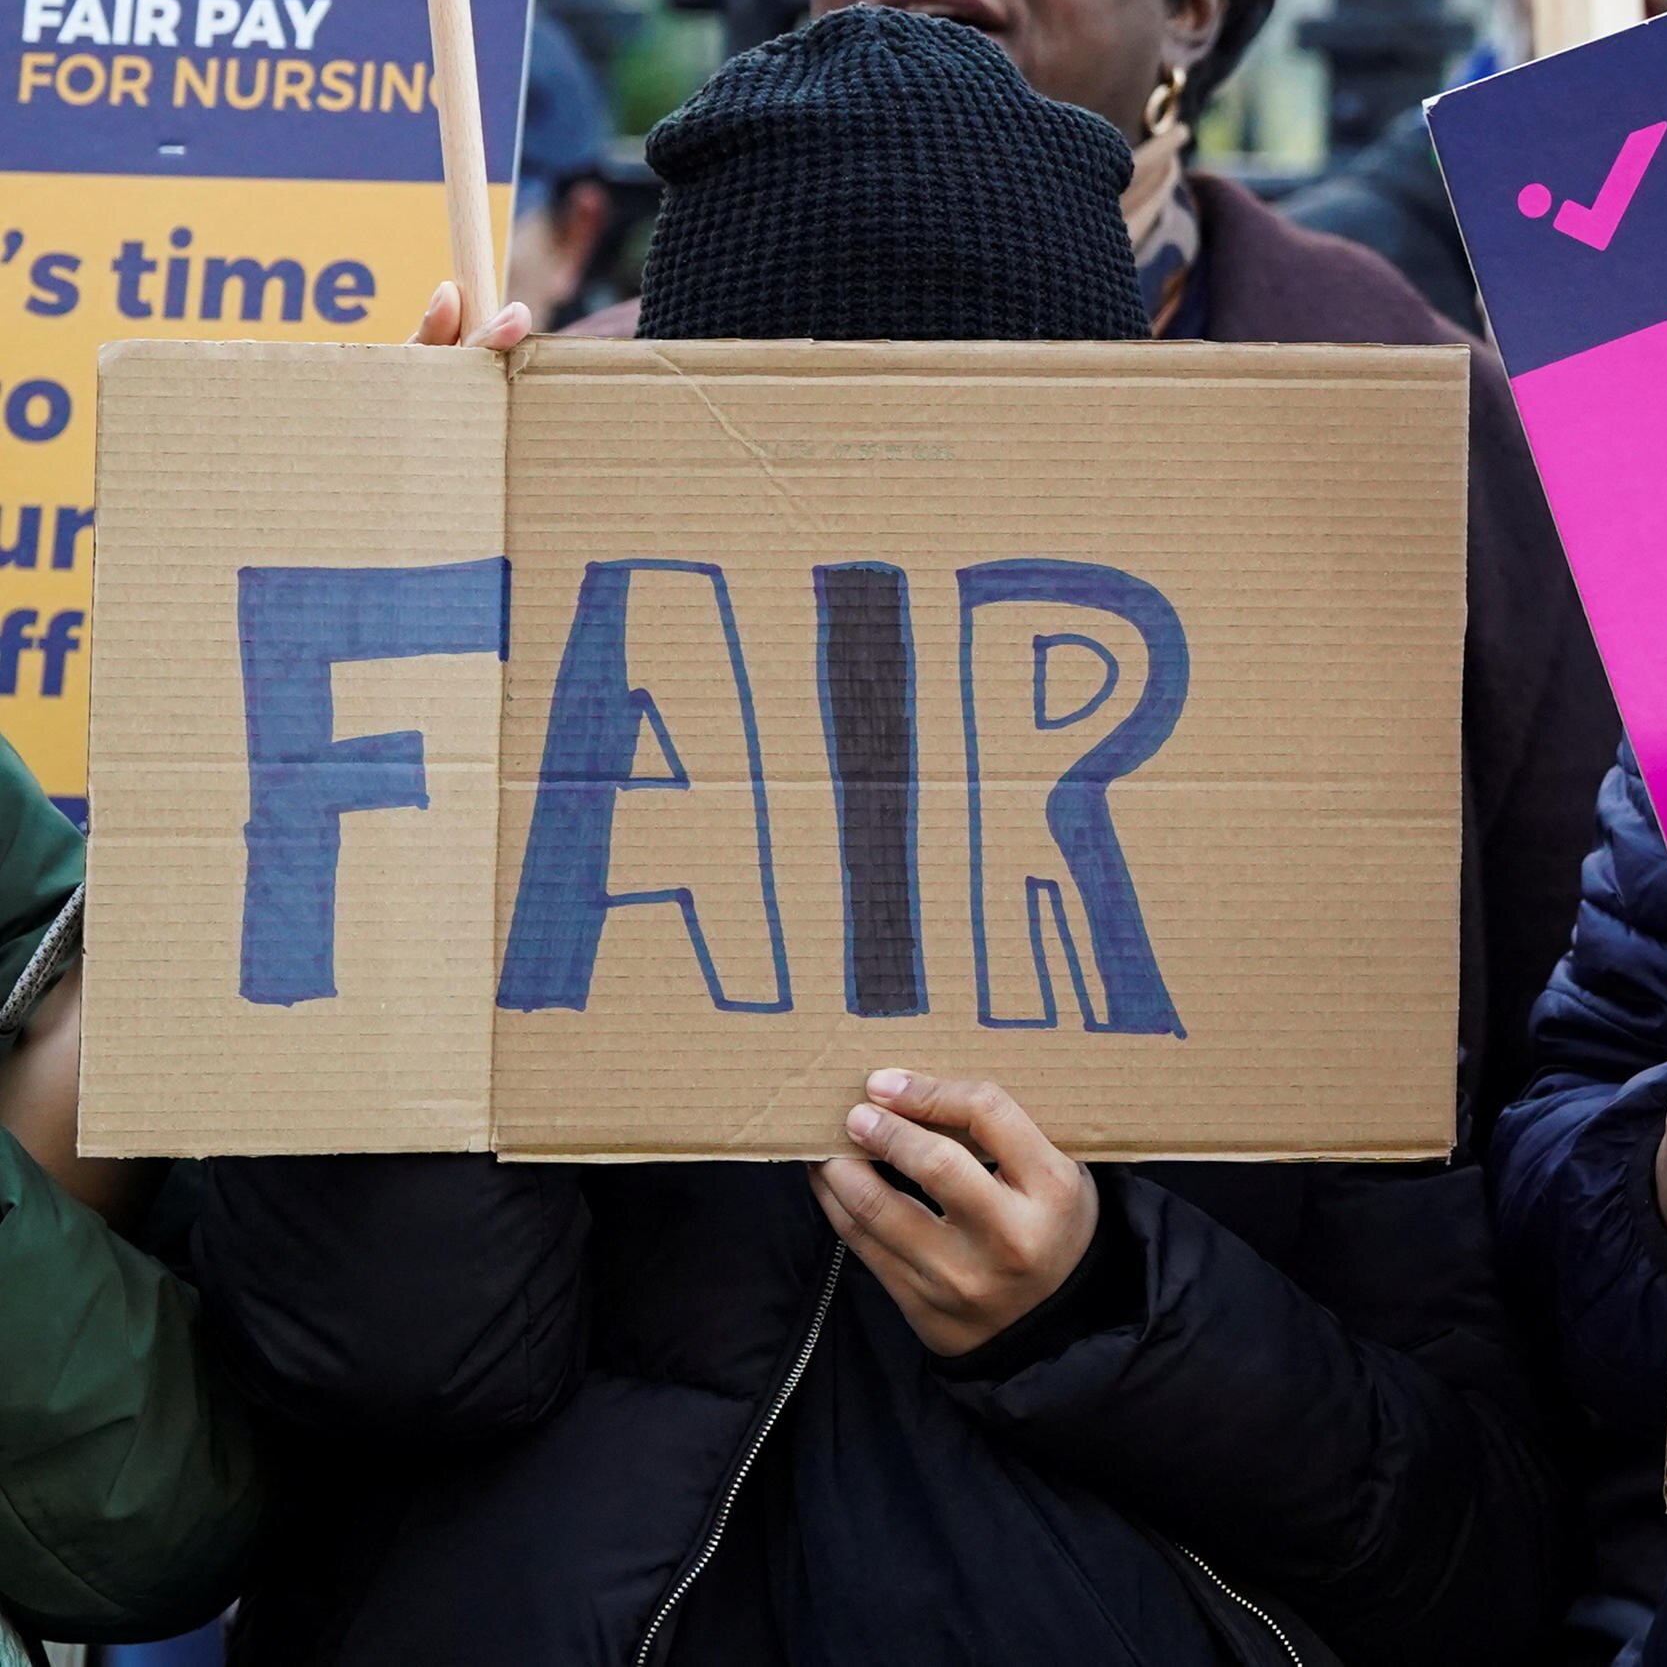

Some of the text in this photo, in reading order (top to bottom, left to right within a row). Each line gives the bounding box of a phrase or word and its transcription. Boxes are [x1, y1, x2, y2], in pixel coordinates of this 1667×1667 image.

[17, 52, 154, 107] FOR
[111, 227, 377, 323] time
[0, 377, 73, 442] o
[237, 555, 1190, 1040] FAIR
